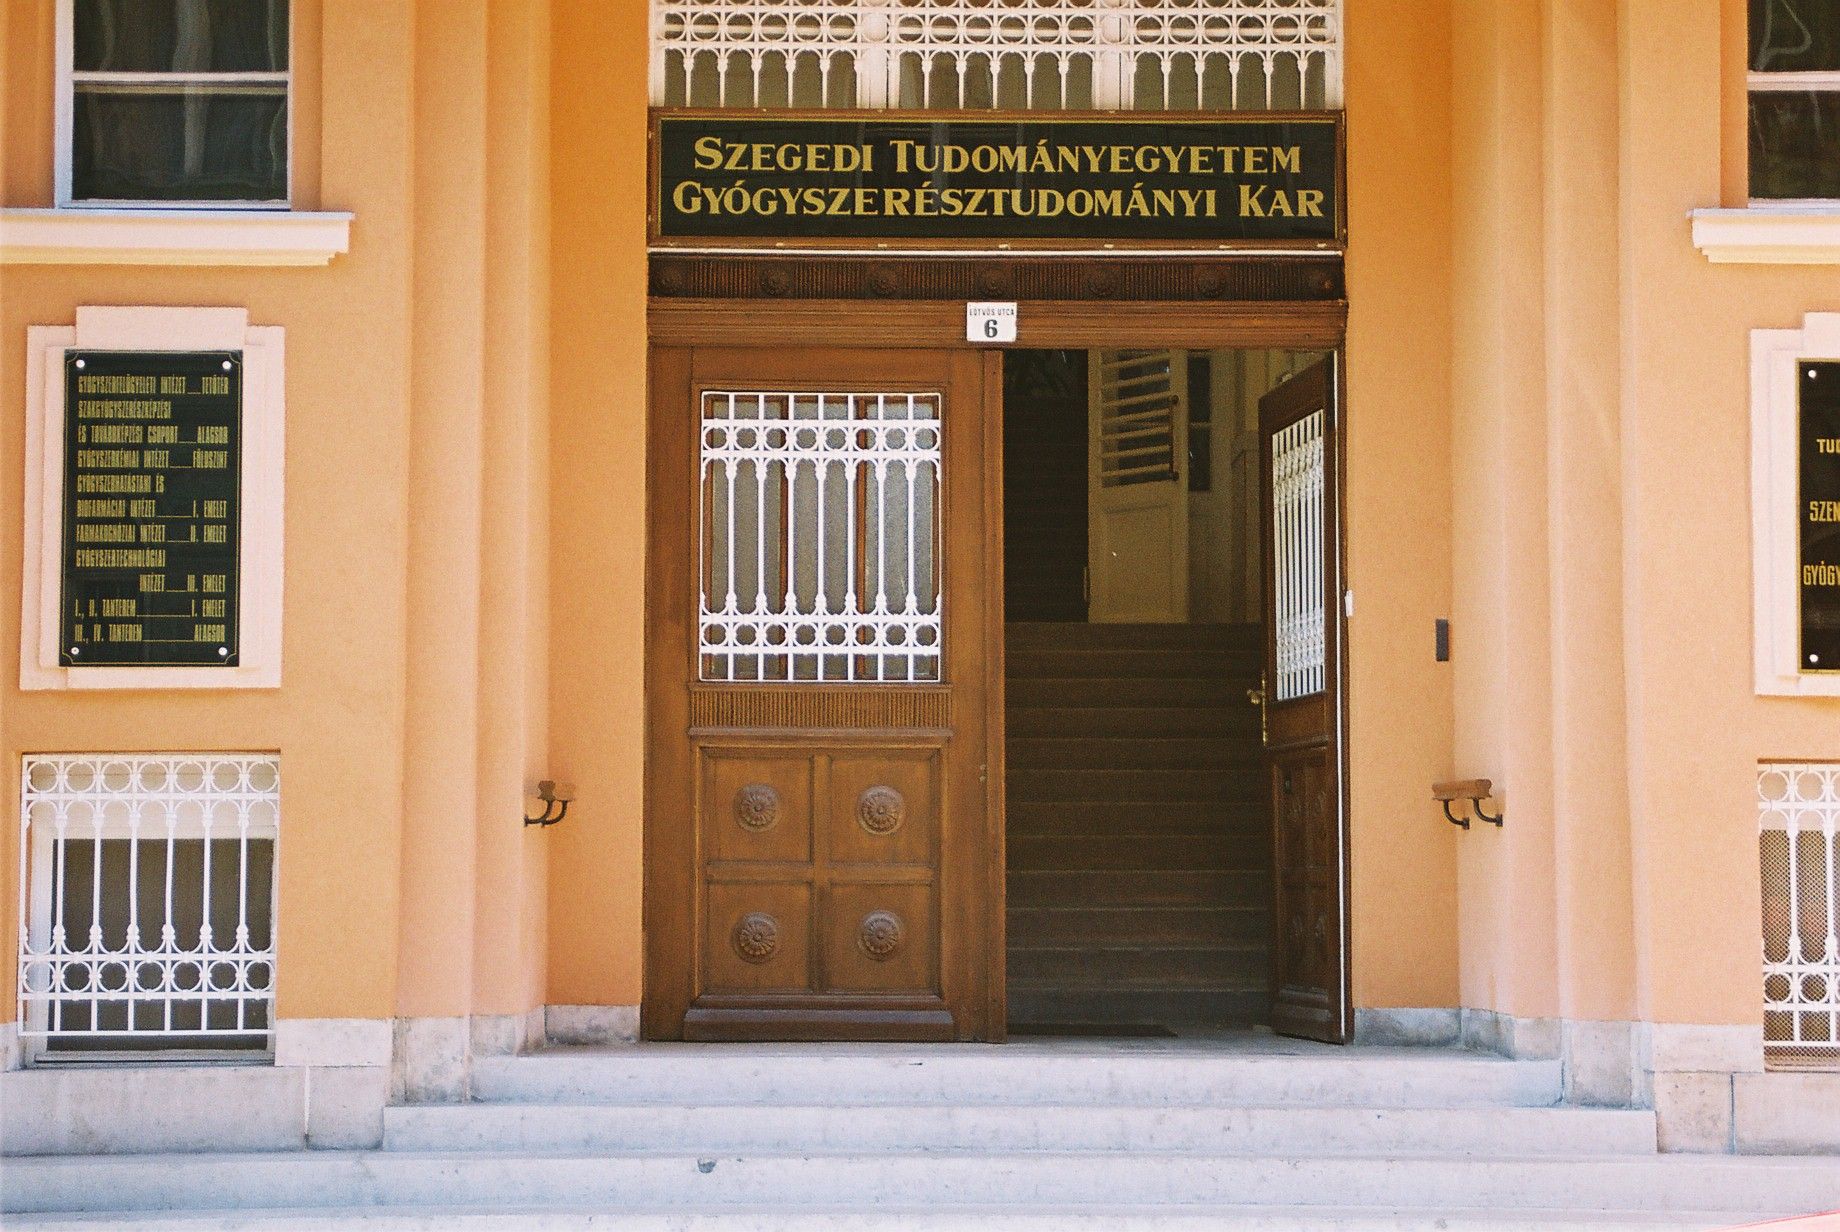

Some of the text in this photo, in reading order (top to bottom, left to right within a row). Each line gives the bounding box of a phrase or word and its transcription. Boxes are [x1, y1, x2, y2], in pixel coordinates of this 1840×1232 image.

[693, 137, 1301, 174] SZEGEDI TUDOMÁNYEGYETEM
[673, 180, 1325, 218] GYÓGYSZERÉSZTUDOMÁNYI KAR
[984, 319, 998, 338] 6
[160, 374, 186, 394] INTÉZET
[143, 448, 170, 468] INTÉZET
[130, 498, 156, 518] INTÉZET
[203, 500, 227, 518] EMELET
[140, 523, 166, 543] INTÉZET
[203, 525, 227, 543] EMELET
[139, 572, 165, 593] INTÉZET
[202, 574, 226, 593] EMELET
[102, 599, 136, 618] TANTEREM
[202, 599, 226, 618] EMELET
[109, 624, 143, 643] TANTEREM
